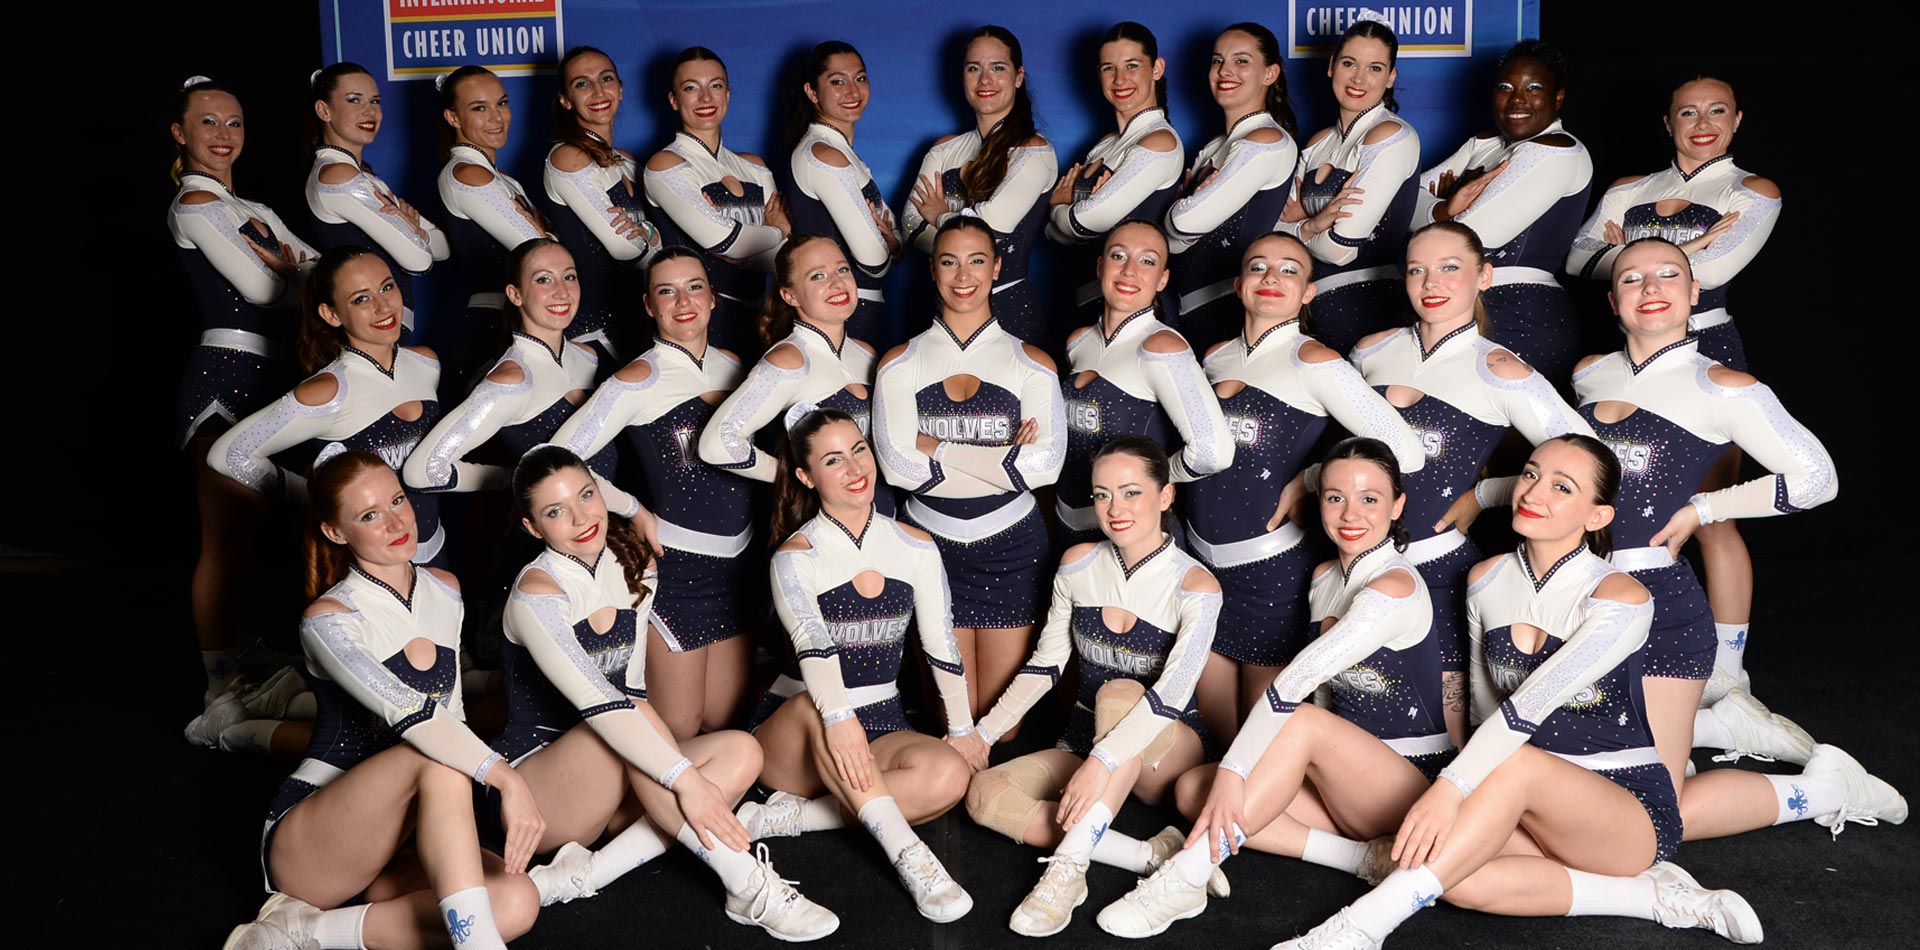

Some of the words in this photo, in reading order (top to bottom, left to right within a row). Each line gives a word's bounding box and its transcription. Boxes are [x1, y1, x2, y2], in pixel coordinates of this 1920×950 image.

[1306, 8, 1370, 35] CHEE
[402, 29, 467, 58] CHEER
[476, 26, 545, 56] UNION
[918, 417, 1009, 441] WOLVES
[825, 619, 908, 643] WOLVES
[1076, 637, 1164, 674] WOLVES
